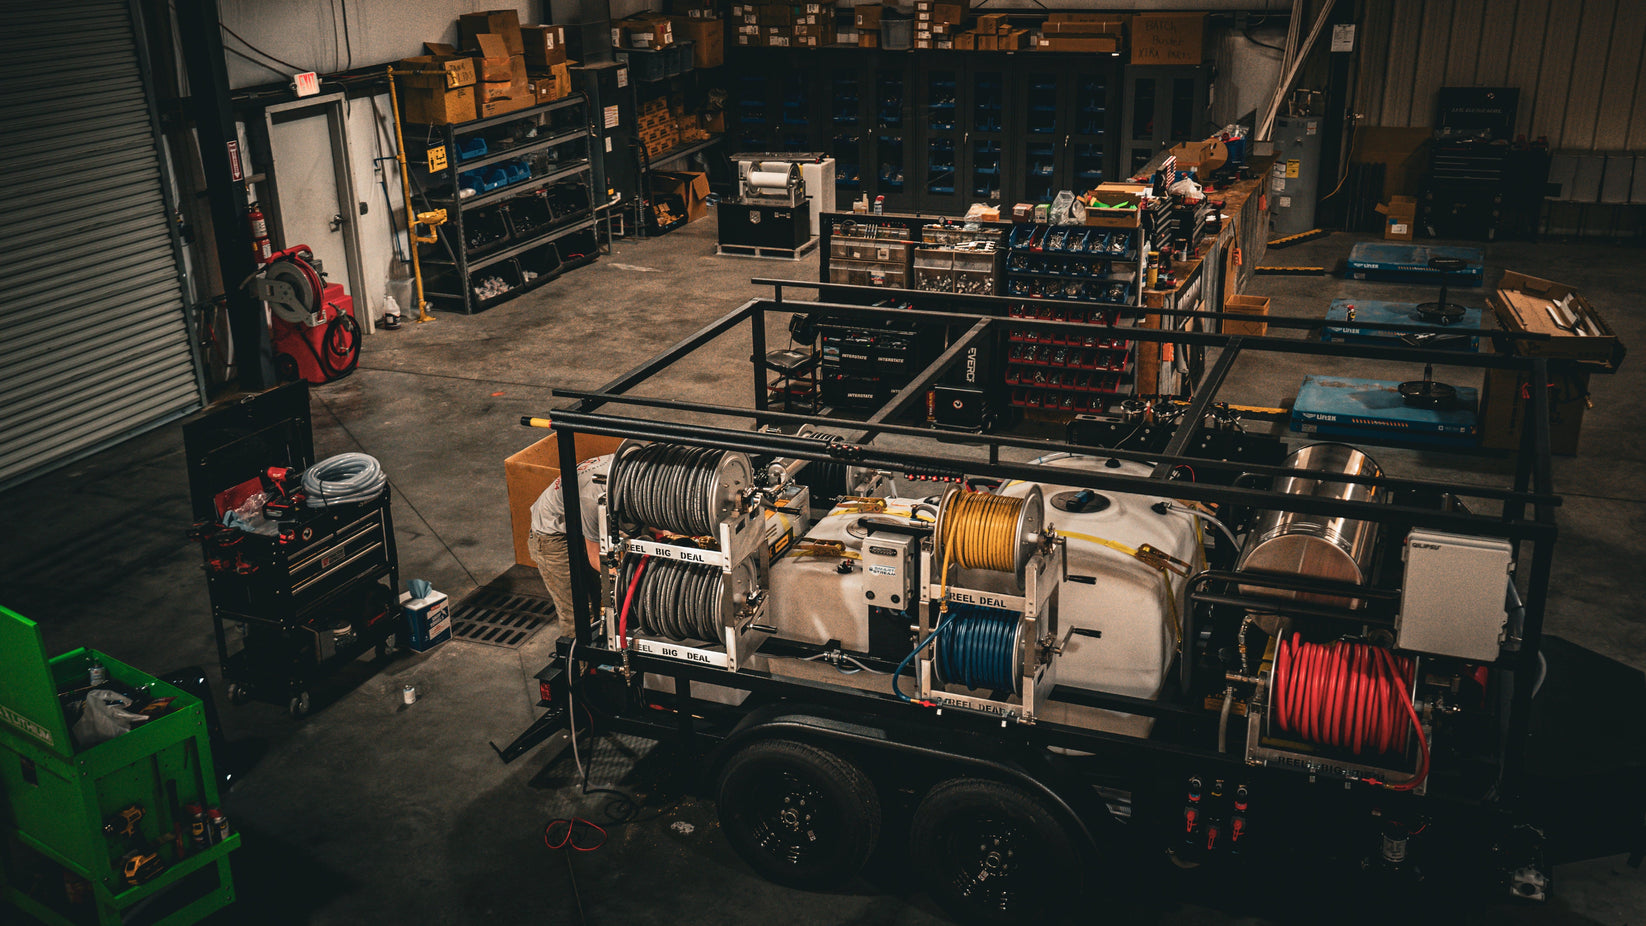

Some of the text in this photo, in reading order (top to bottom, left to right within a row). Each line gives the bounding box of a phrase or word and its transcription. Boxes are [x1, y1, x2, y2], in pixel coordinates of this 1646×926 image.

[298, 72, 315, 89] EXIT
[841, 353, 868, 361] INTERSTATE
[656, 547, 671, 557] BIG
[680, 551, 704, 563] DEAL
[949, 592, 1007, 608] REEL DEAL
[662, 647, 678, 657] BIG
[687, 652, 711, 663] DEAL
